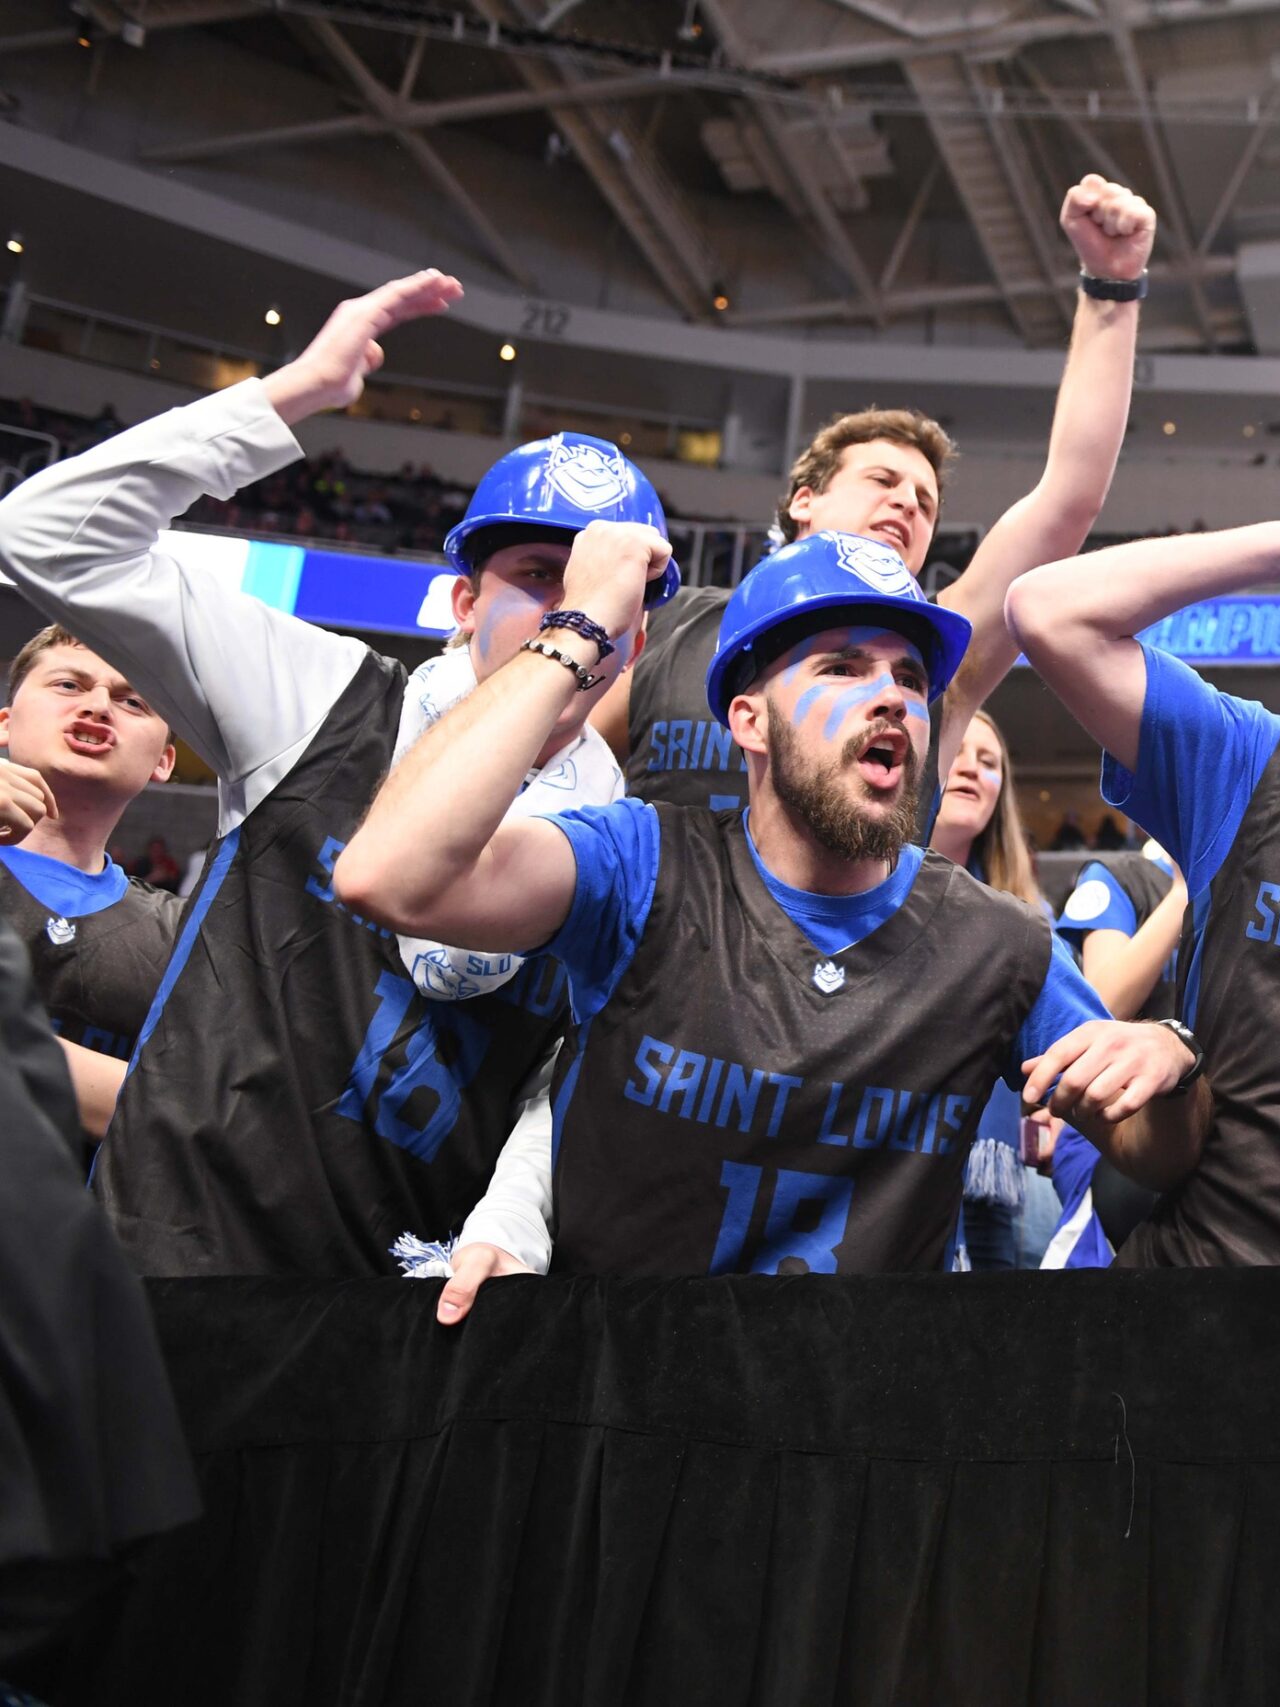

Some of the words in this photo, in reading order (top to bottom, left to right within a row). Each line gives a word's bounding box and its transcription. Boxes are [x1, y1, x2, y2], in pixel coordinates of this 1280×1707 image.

[521, 300, 571, 337] 212
[647, 719, 749, 772] SAIN
[466, 954, 512, 976] SLU
[624, 1034, 804, 1138] SAINT
[816, 1081, 971, 1155] LOUIS
